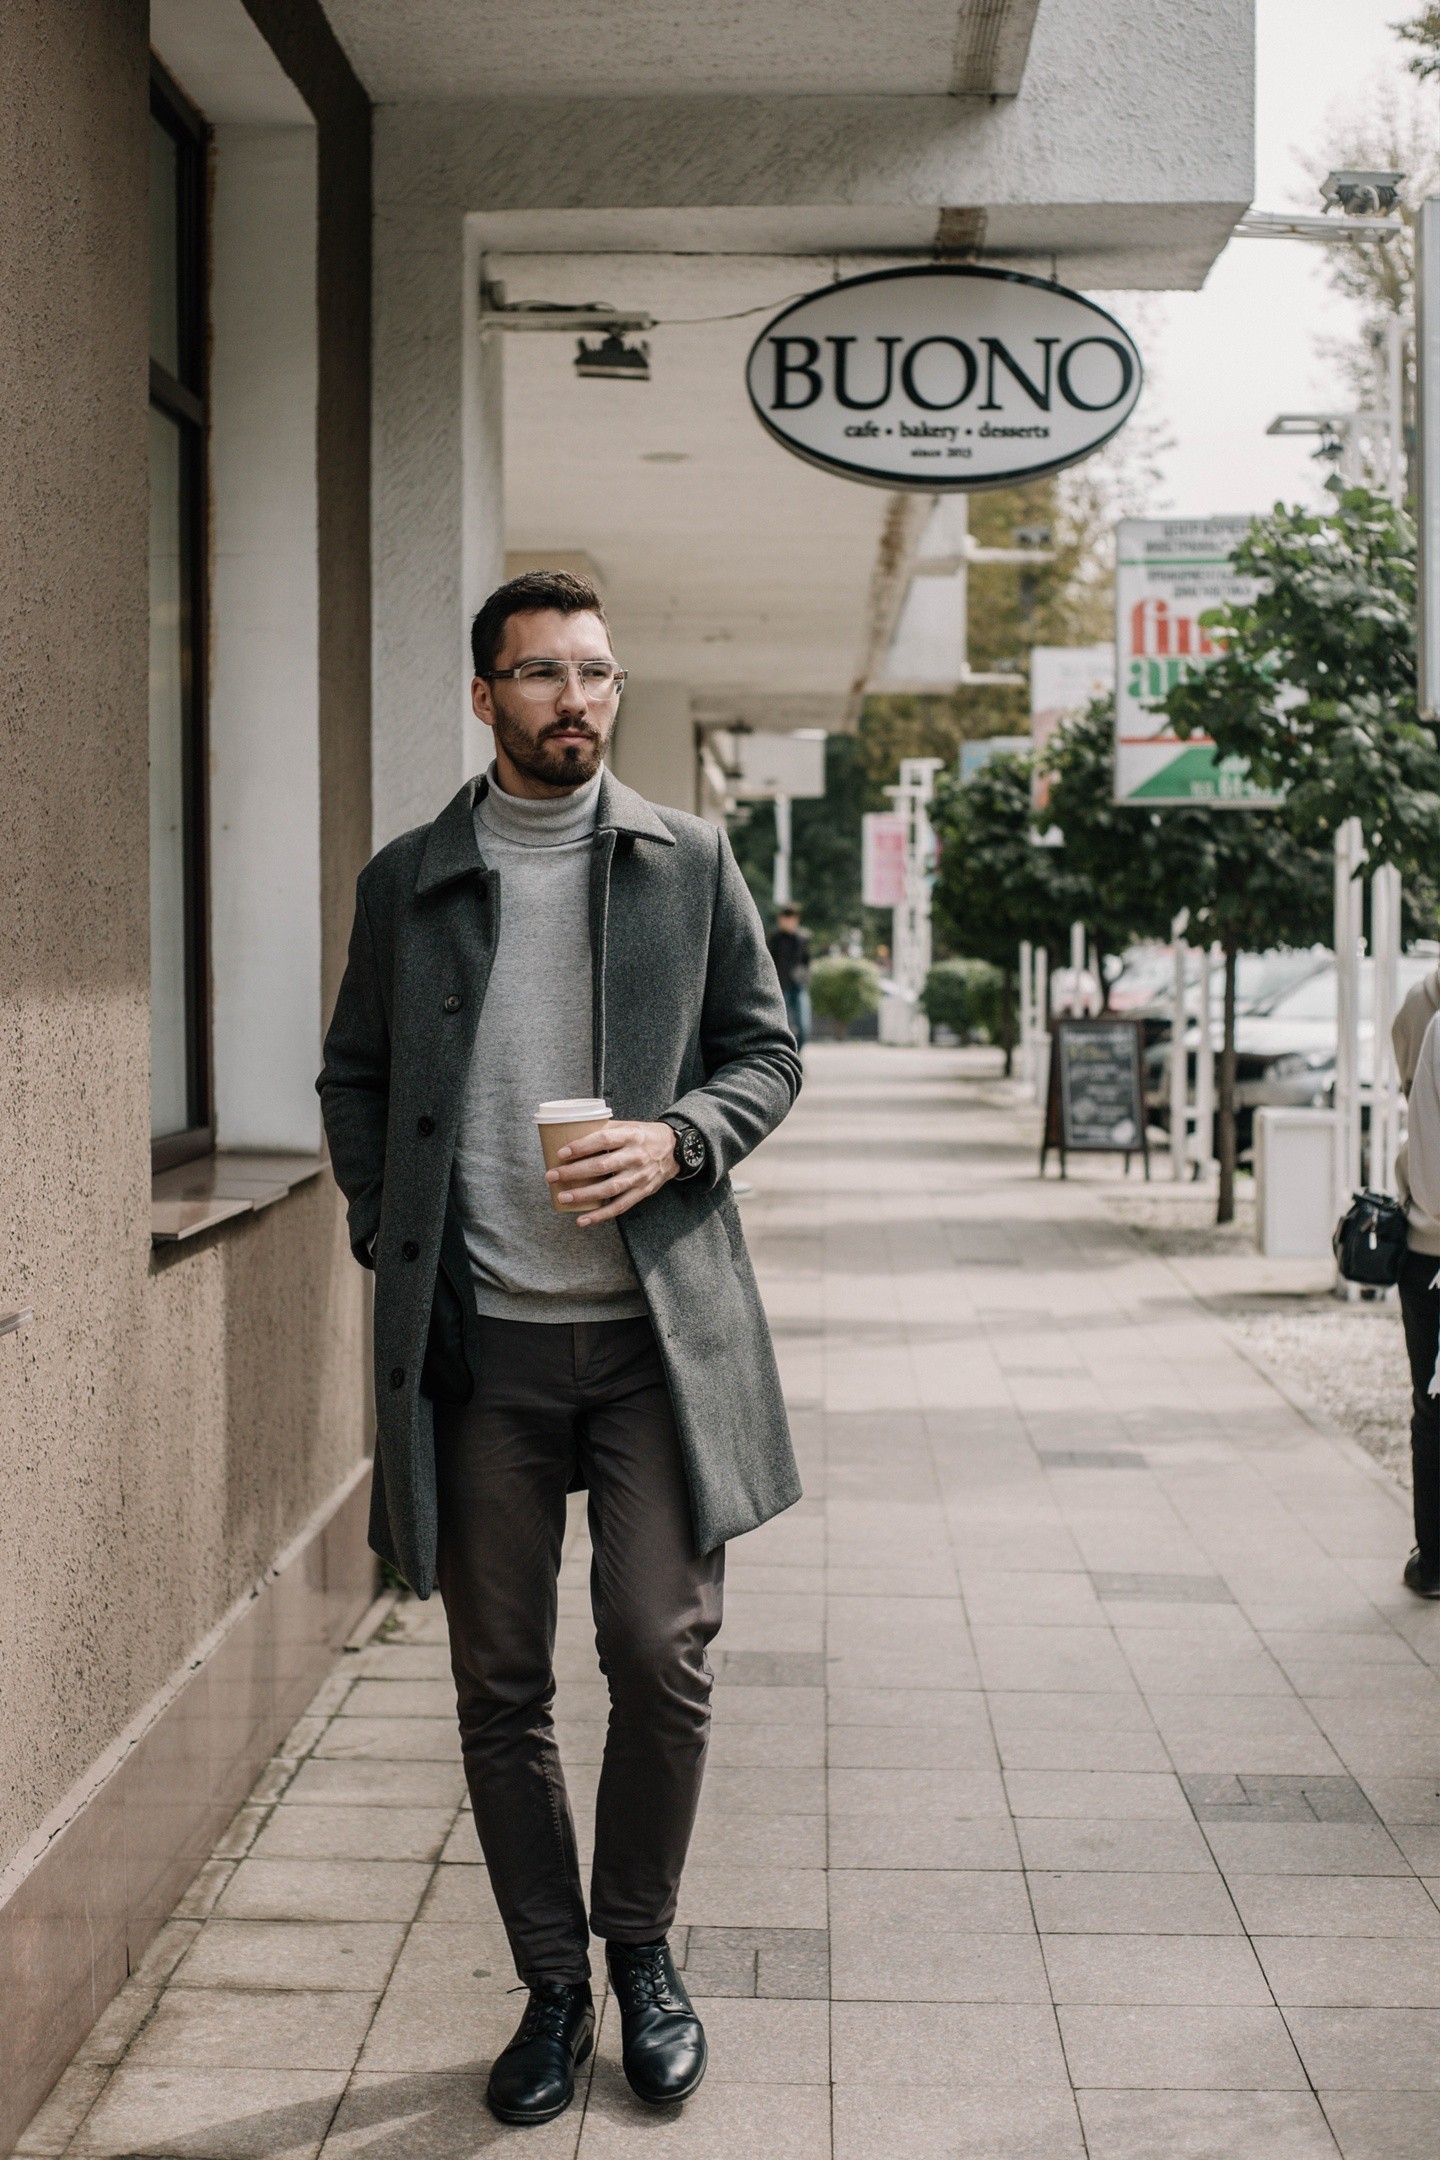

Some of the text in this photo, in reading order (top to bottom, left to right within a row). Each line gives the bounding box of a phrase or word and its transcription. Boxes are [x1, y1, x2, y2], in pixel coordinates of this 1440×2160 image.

[768, 336, 1133, 411] BUONO
[843, 421, 1050, 441] cafe bakery desserts
